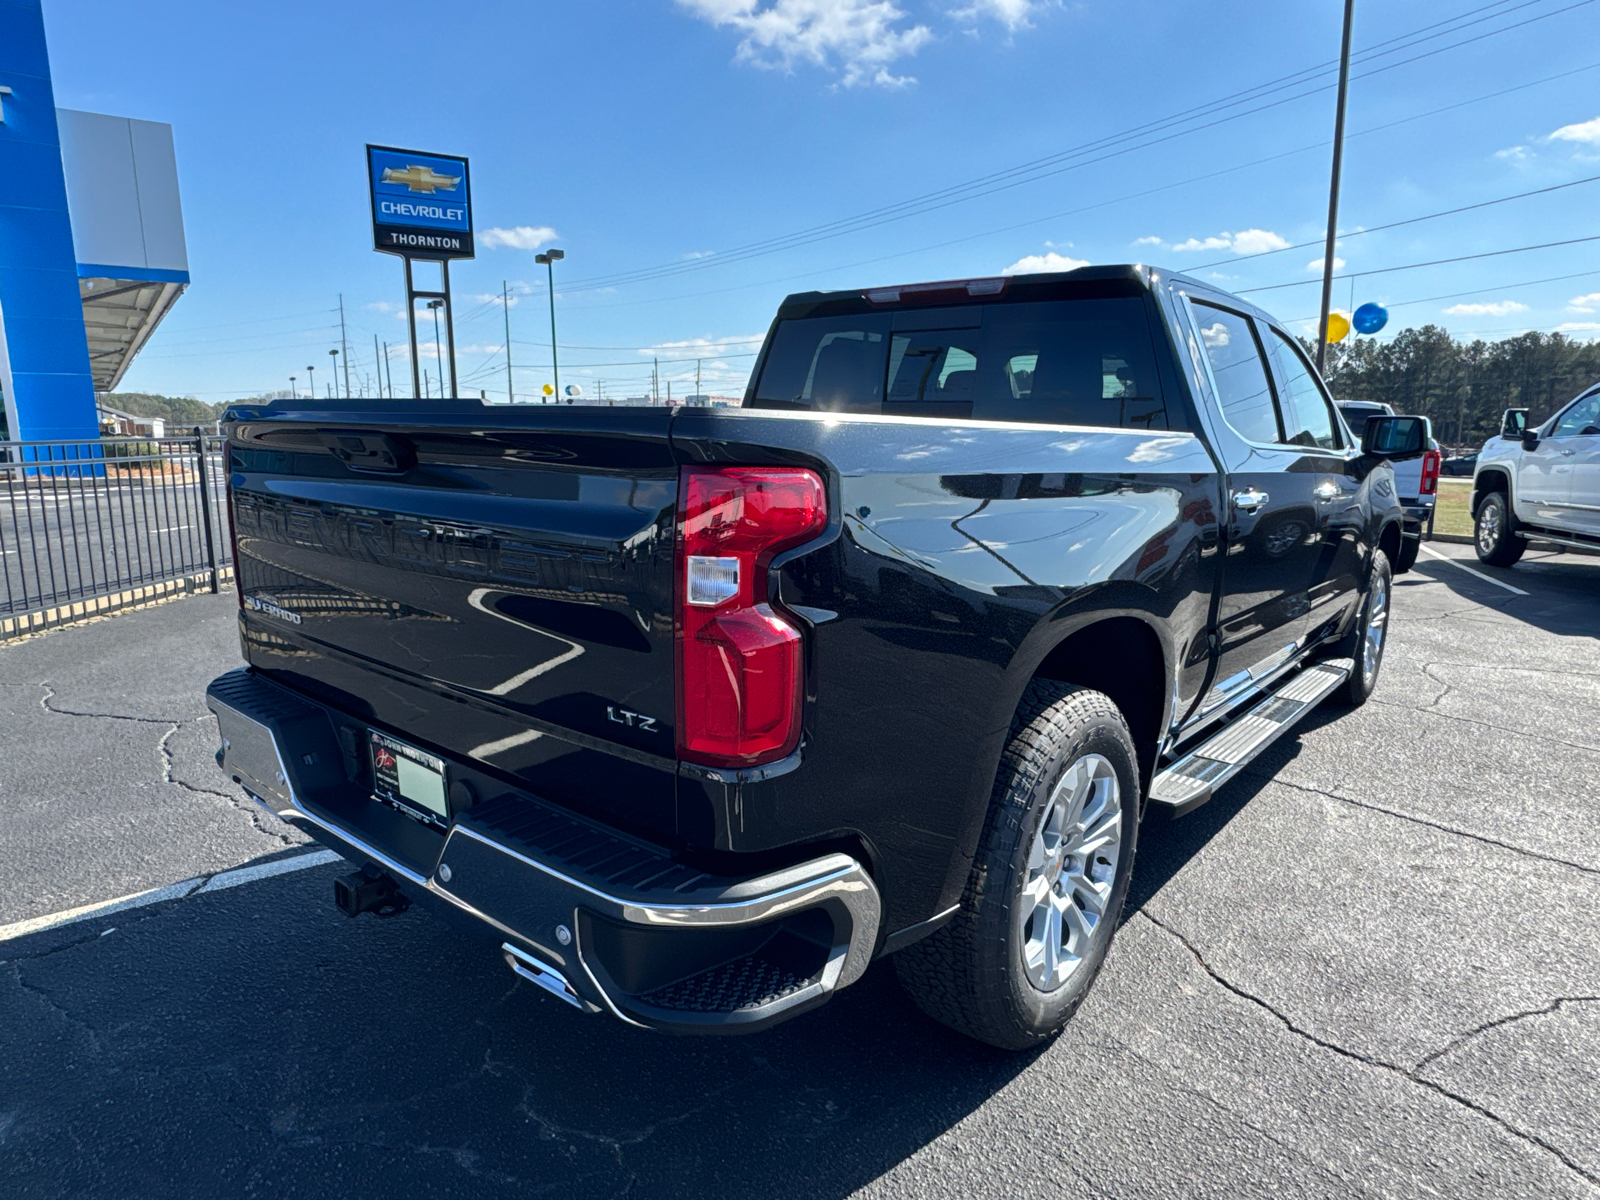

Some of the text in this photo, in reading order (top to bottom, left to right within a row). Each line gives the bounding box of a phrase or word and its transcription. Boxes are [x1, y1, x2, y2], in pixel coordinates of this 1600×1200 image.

[381, 201, 464, 221] CHEVROLET
[391, 232, 460, 249] THORNTON
[606, 705, 658, 733] LTZ
